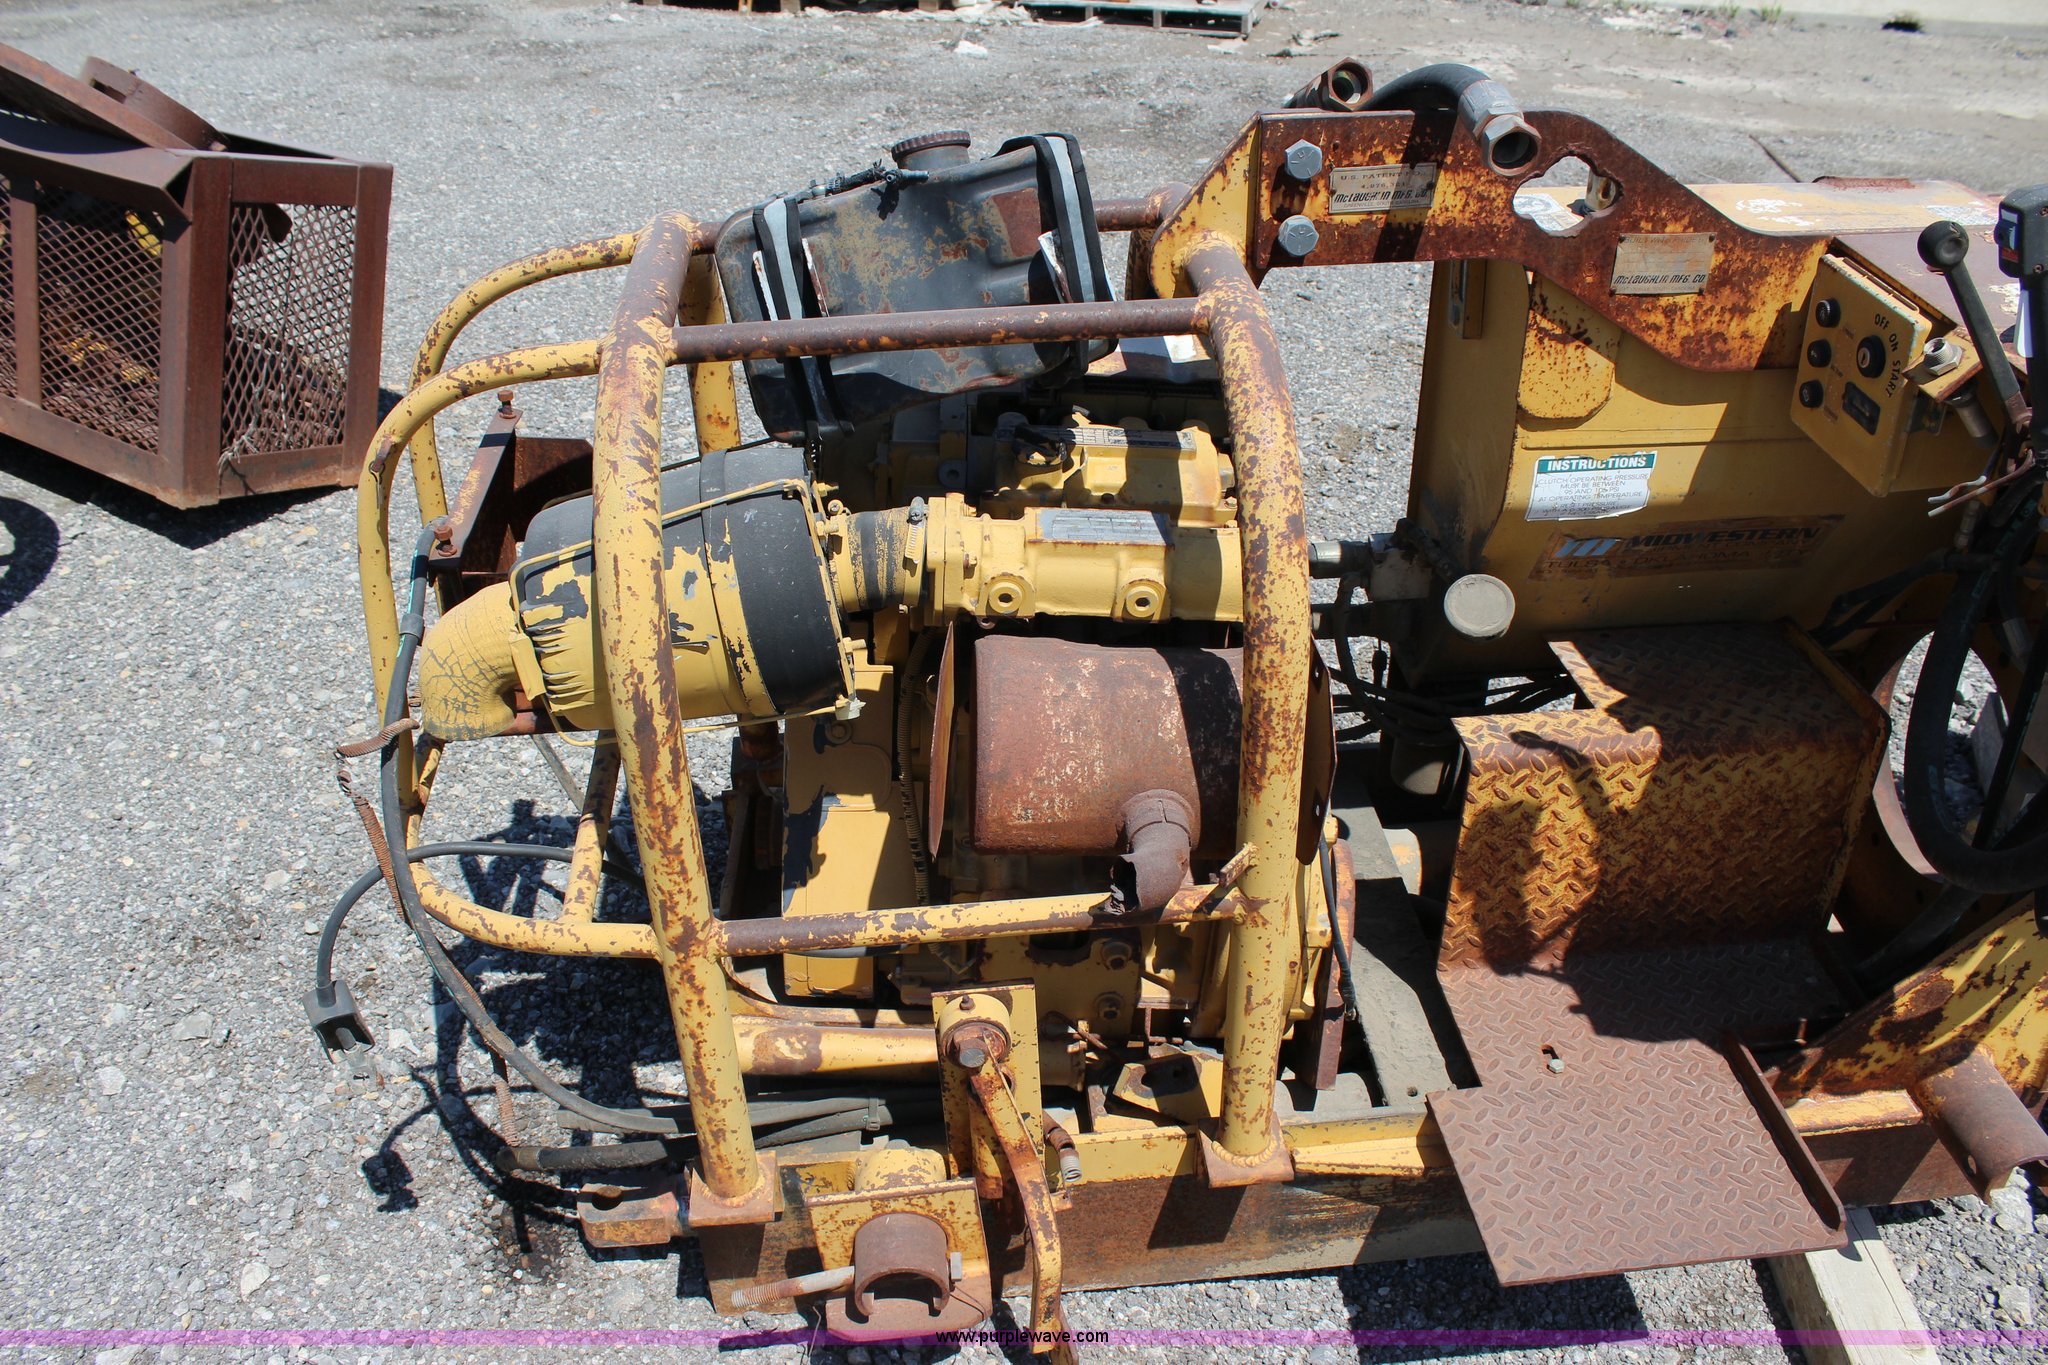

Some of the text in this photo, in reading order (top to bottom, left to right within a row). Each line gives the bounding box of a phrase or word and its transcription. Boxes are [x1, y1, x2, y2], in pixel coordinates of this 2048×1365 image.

[1362, 172, 1402, 180] PATENT
[1874, 313, 1901, 398] OFF ON START
[1547, 456, 1647, 471] INSTRUCTIONS
[1569, 475, 1613, 483] OPERATING
[1548, 494, 1592, 502] OPERATING
[1593, 491, 1642, 499] TEMPERATURE
[1625, 527, 1821, 548] MIDWESTERN
[1545, 558, 1611, 569] TULSA
